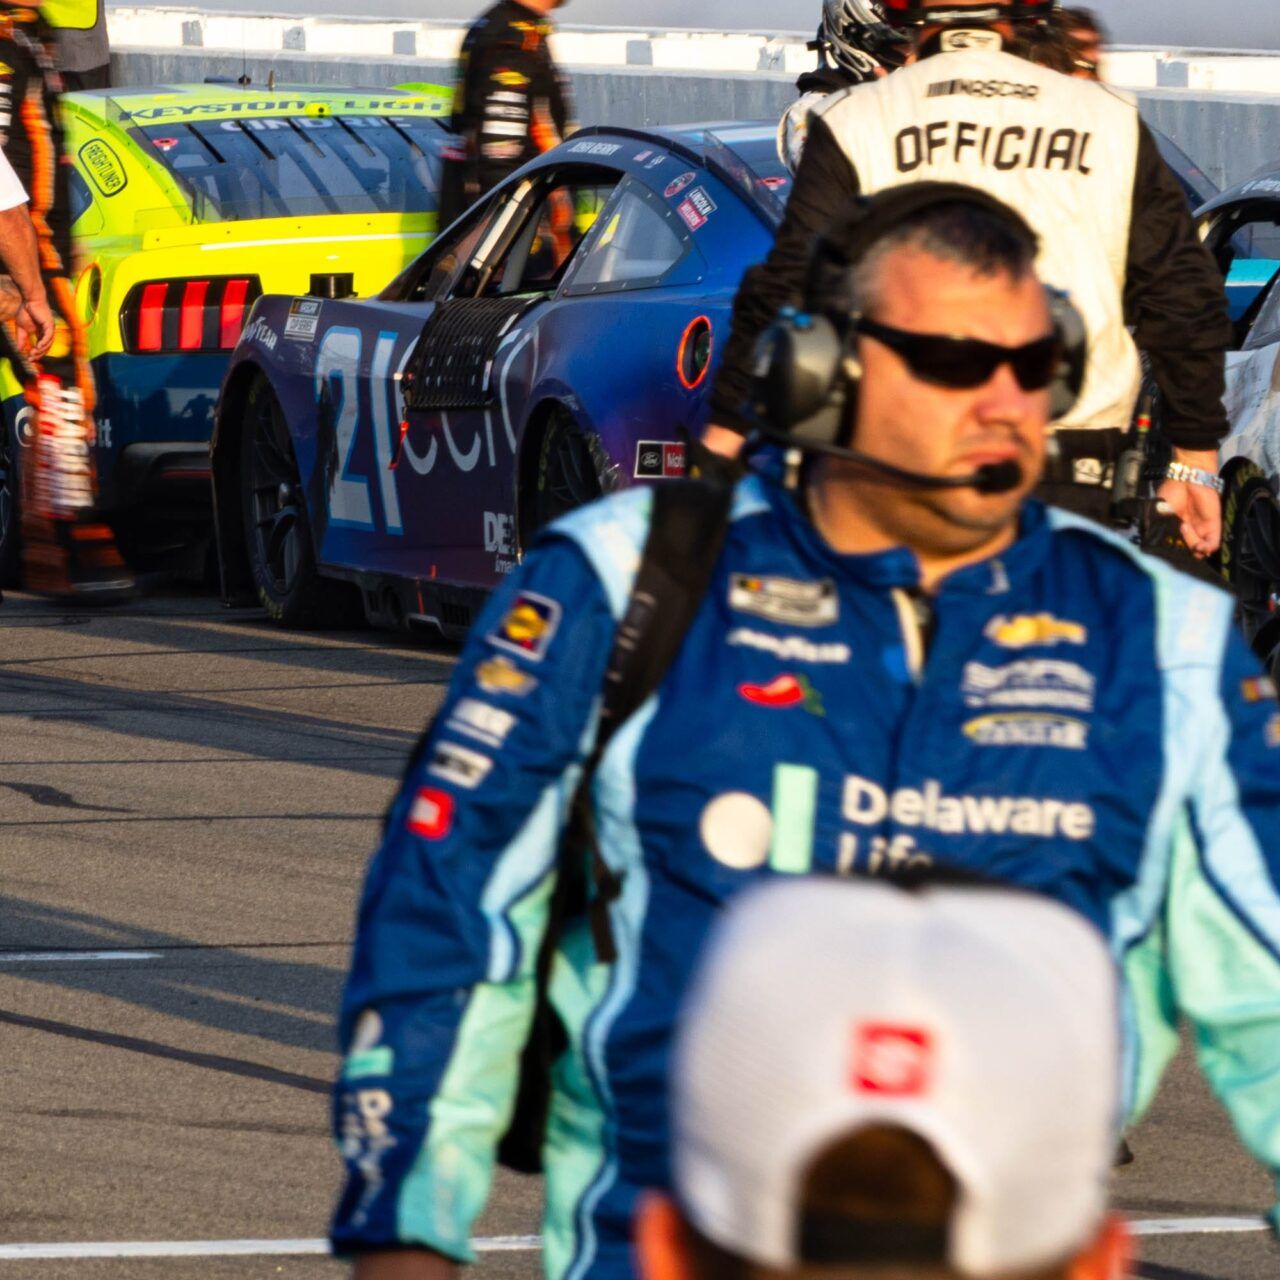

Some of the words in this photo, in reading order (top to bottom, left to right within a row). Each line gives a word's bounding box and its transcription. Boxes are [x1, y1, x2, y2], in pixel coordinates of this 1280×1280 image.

[119, 100, 355, 121] KEYSTON
[958, 77, 1039, 102] NASCAR
[86, 143, 122, 194] FREIGHTLINER
[894, 120, 1092, 175] OFFICIAL
[314, 325, 404, 535] 21
[842, 775, 1094, 841] Delaware
